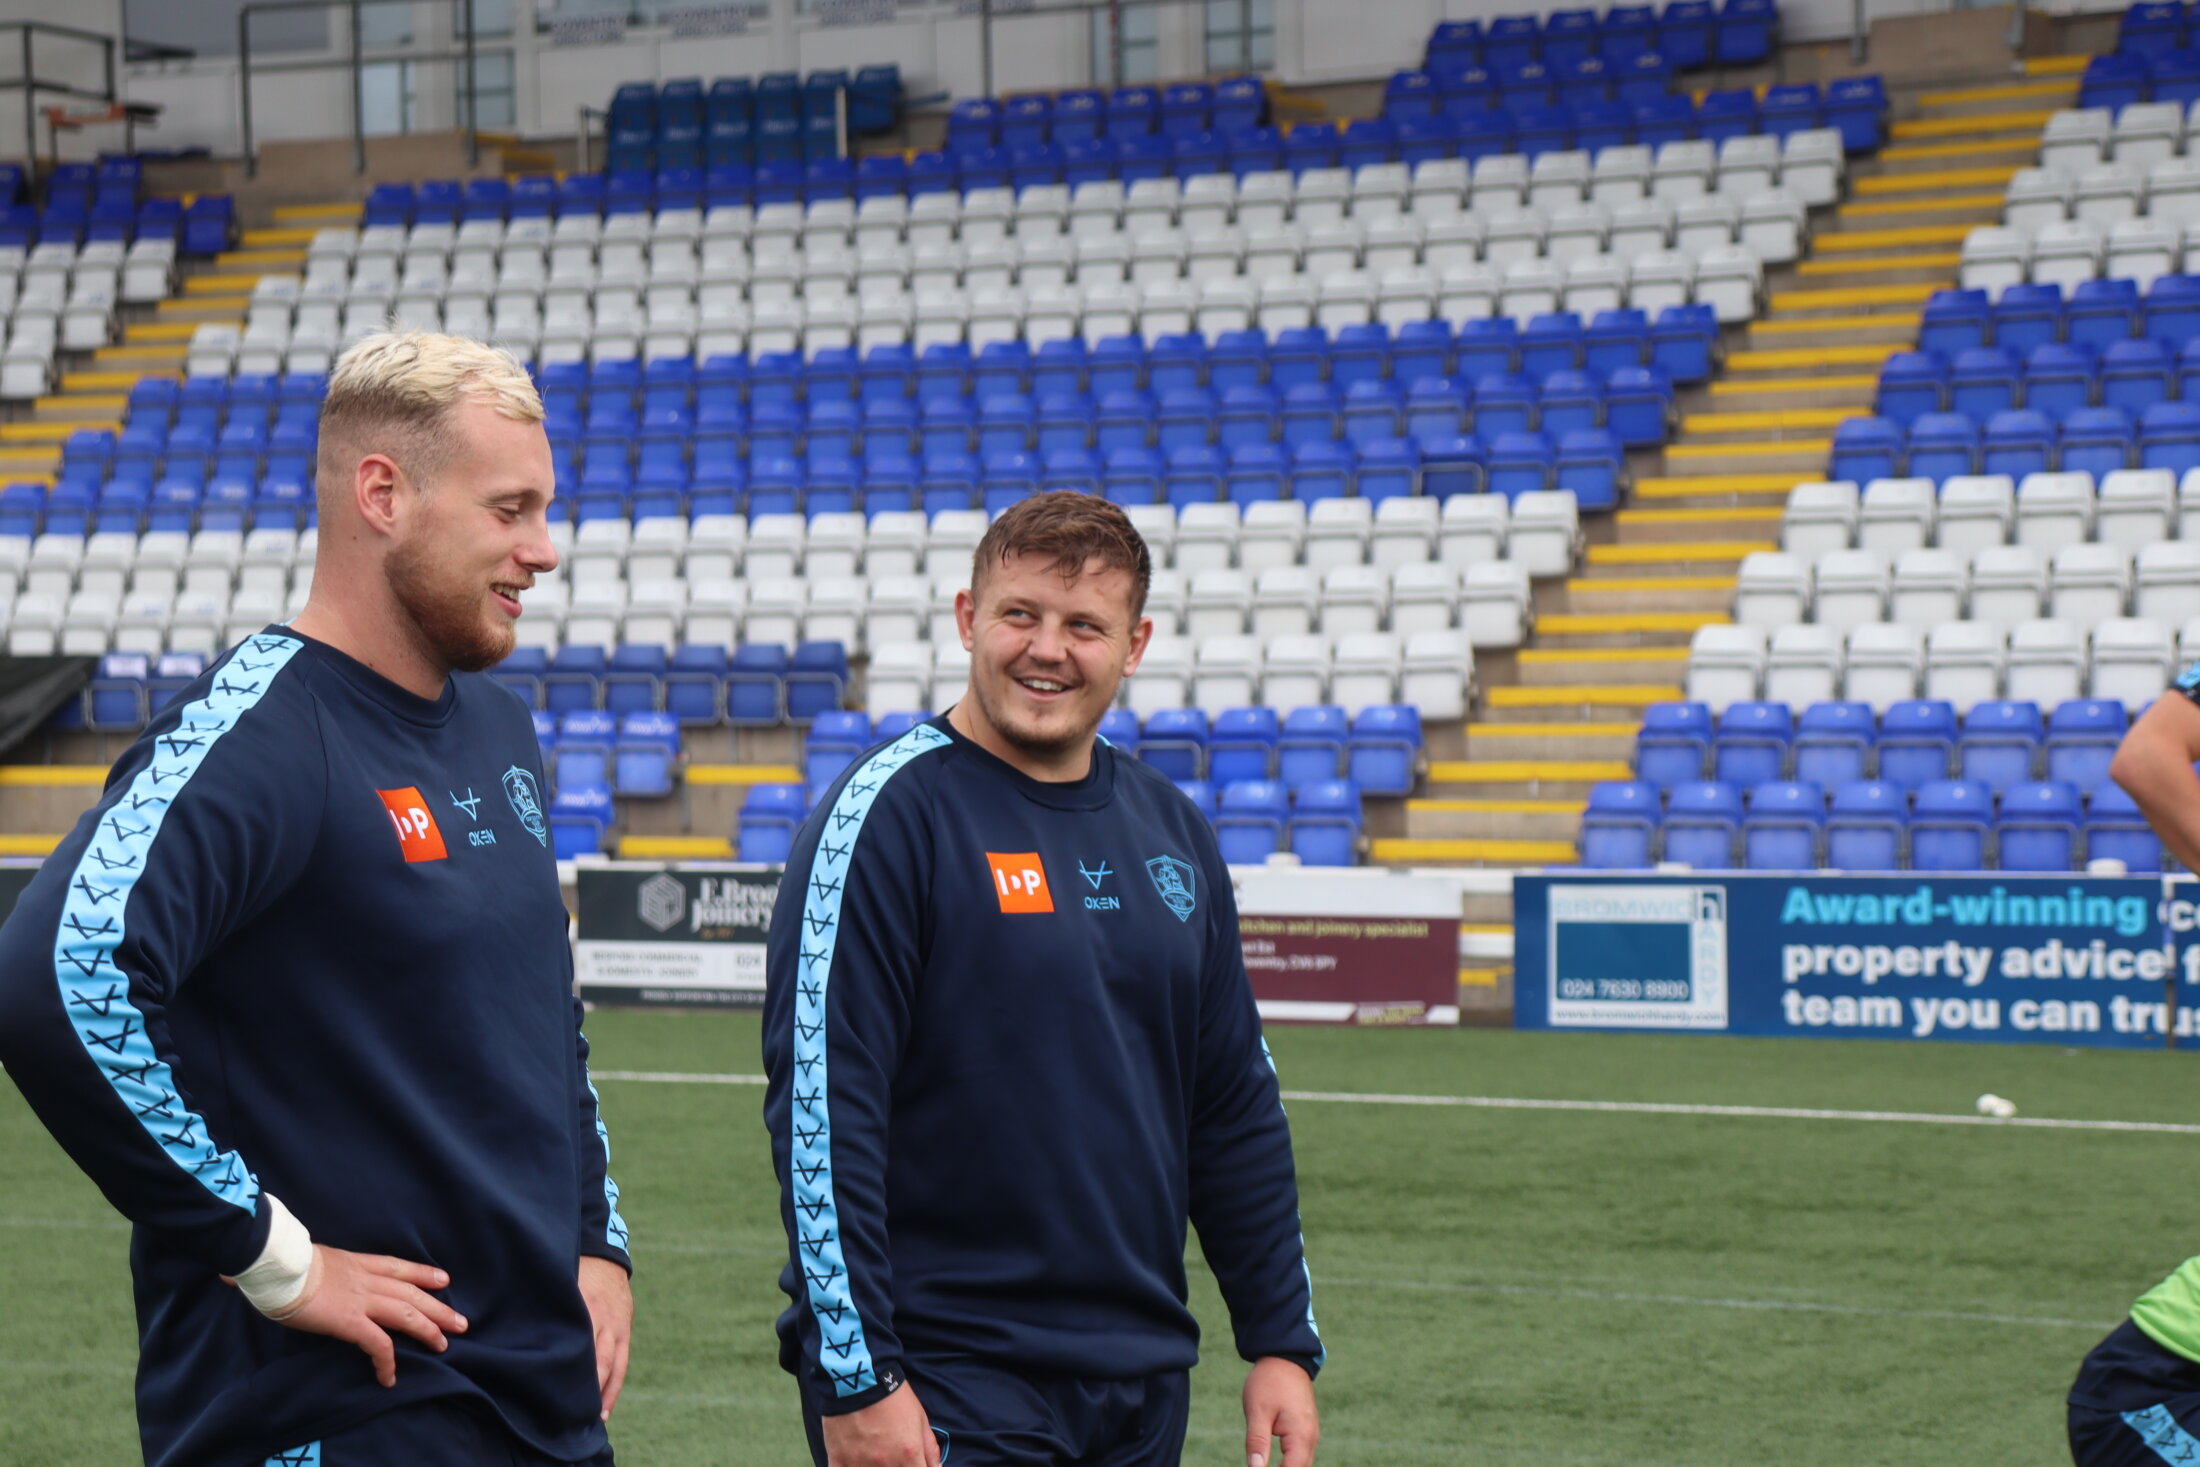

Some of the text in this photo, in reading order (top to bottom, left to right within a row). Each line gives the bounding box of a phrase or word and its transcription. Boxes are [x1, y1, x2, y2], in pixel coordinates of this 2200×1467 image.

[1084, 896, 1121, 910] OXEN
[1781, 885, 2147, 937] Award-winning
[1782, 940, 1993, 987] property
[2000, 938, 2167, 981] advice
[1559, 978, 1596, 998] 024
[1598, 978, 1643, 1000] 7630
[1781, 988, 1903, 1028] team
[1910, 996, 2001, 1038] you
[2009, 998, 2101, 1032] can
